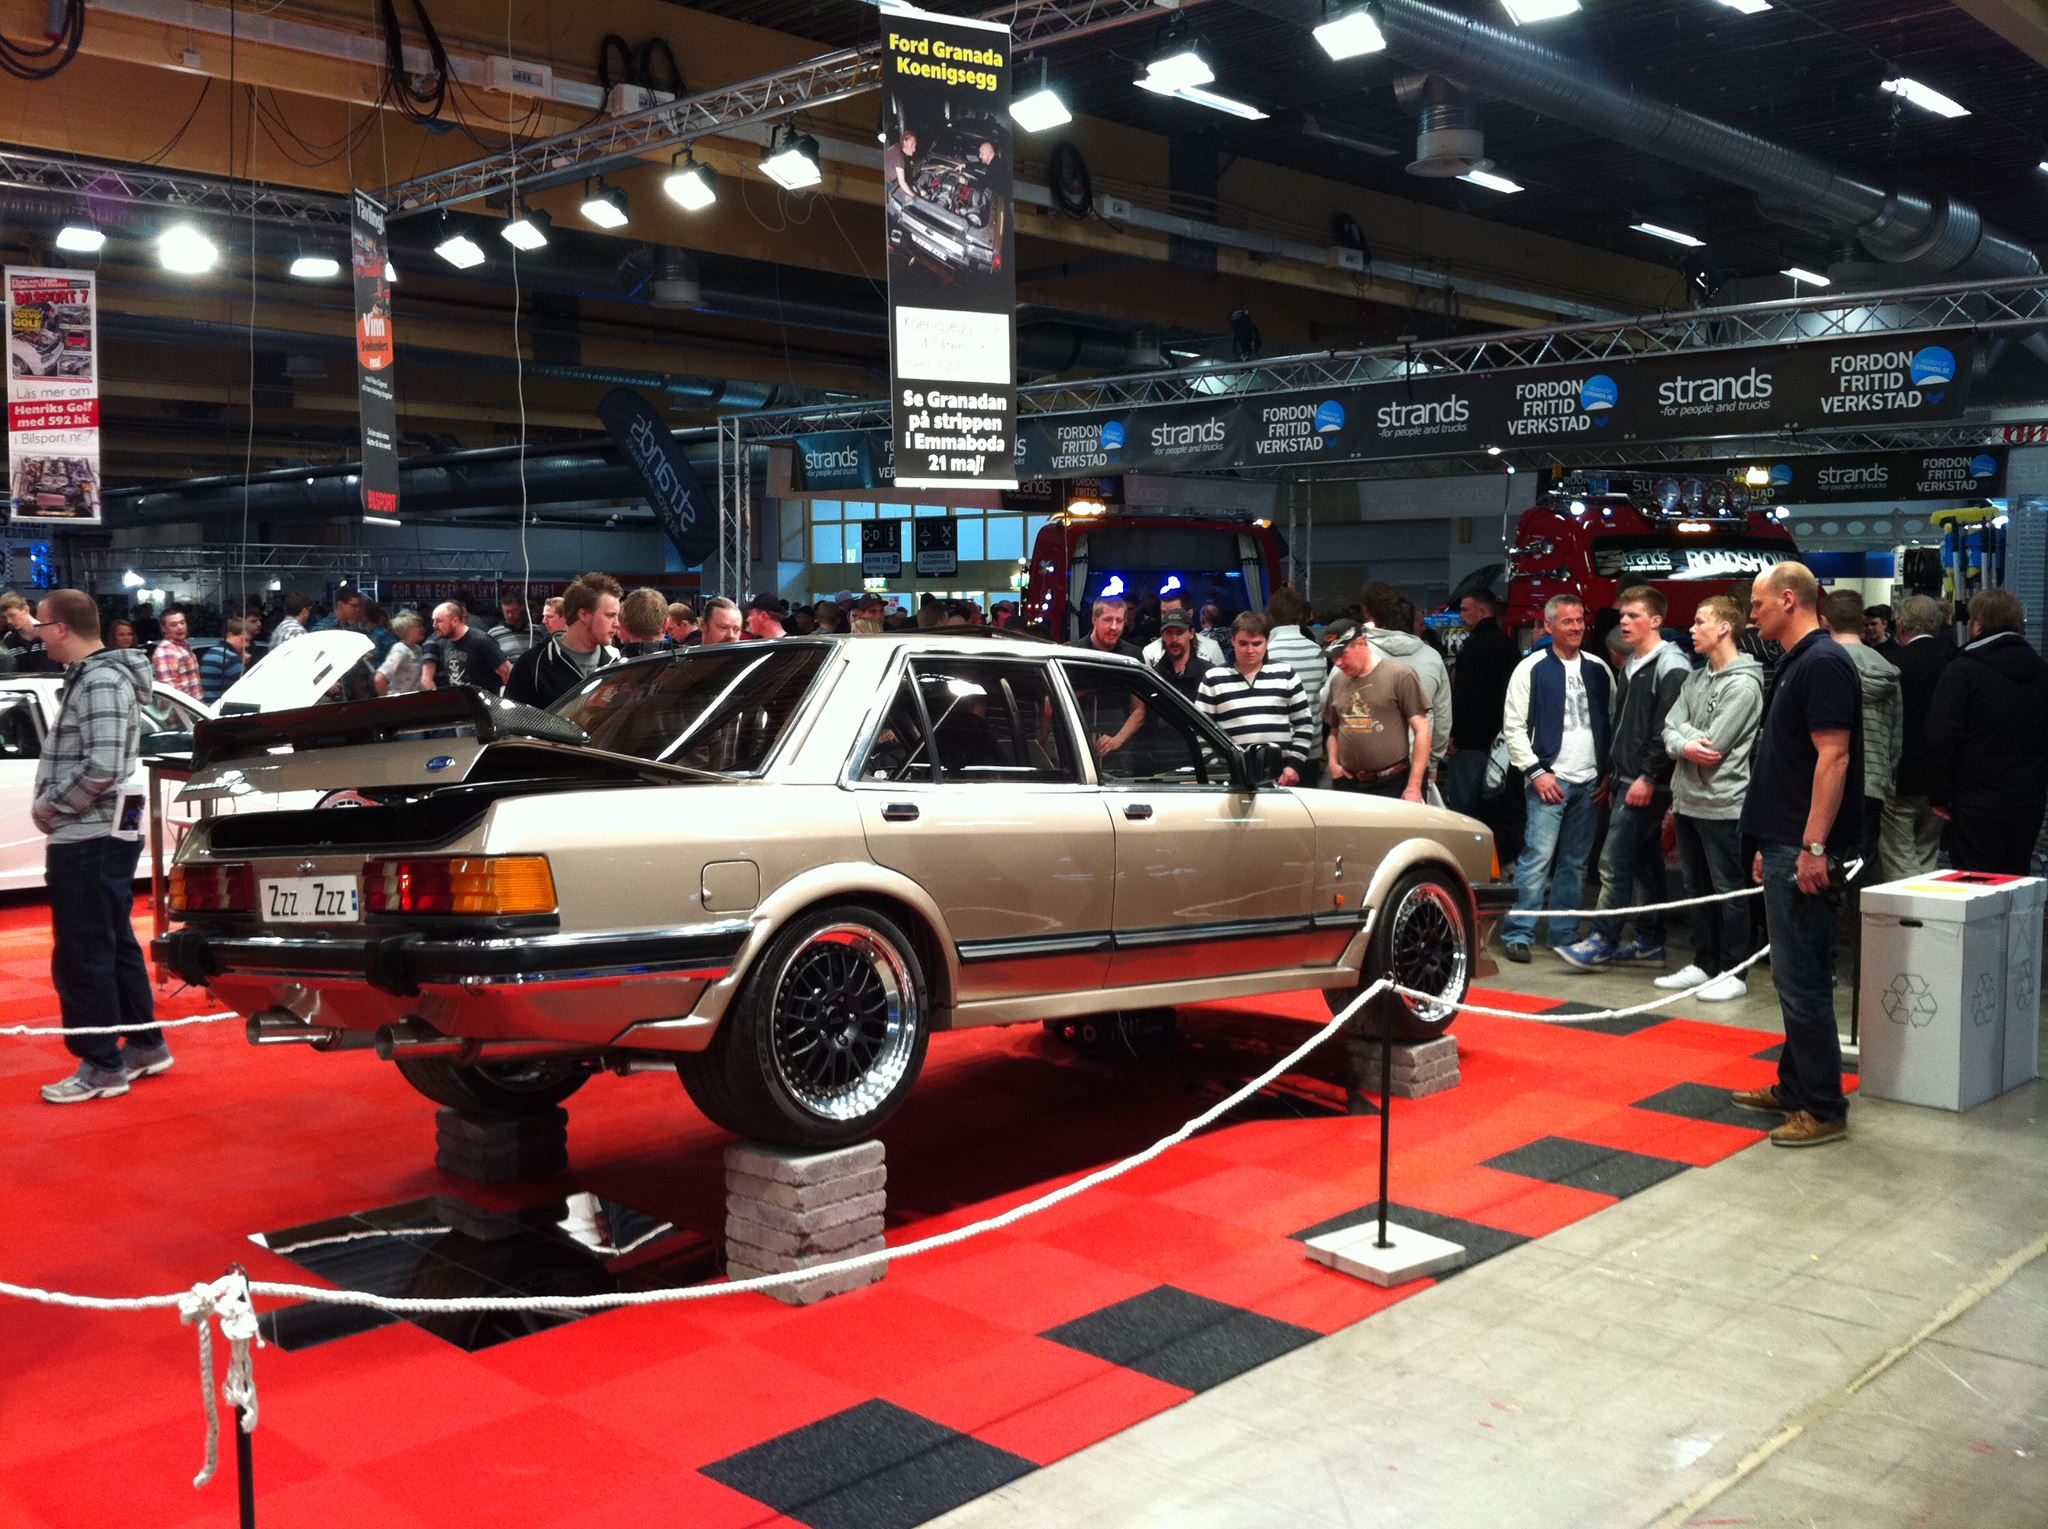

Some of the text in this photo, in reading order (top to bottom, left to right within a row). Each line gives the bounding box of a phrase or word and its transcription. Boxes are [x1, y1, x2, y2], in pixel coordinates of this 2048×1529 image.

[889, 33, 1004, 67] Ford Granada
[896, 56, 998, 91] Koenigsegg
[80, 289, 89, 304] 7
[362, 312, 386, 337] Vinn
[1830, 350, 1914, 374] FORDON
[41, 386, 66, 397] mer
[69, 387, 90, 397] om
[1516, 379, 1584, 400] FORDON
[1658, 367, 1773, 405] strands
[1839, 371, 1904, 393] FRITID
[14, 401, 94, 416] Henriks Golf
[903, 389, 1008, 411] Se Granadan
[1523, 398, 1576, 417] FRITID
[1660, 399, 1771, 418] -for people and trucks
[1820, 390, 1923, 413] VERKSTAD
[17, 414, 91, 428] med 592 hk
[1262, 404, 1318, 423] FORDON
[1377, 394, 1469, 428] strands
[908, 409, 1003, 434] på strippen
[1151, 417, 1226, 446] strands
[1268, 421, 1311, 438] FRITID
[1394, 426, 1423, 438] people
[1423, 424, 1441, 434] and
[1441, 422, 1468, 433] trucks
[1507, 415, 1591, 436] VERKSTAD
[21, 432, 66, 446] Bilsport
[1057, 424, 1103, 440] FORDON
[914, 432, 1006, 453] Emmaboda
[1062, 439, 1098, 454] FRITID
[1165, 444, 1188, 456] people
[1188, 443, 1202, 453] and
[1202, 442, 1225, 452] trucks
[1256, 436, 1324, 454] VERKSTAD
[805, 445, 859, 470] strands
[927, 453, 986, 476] 21 maj!
[1051, 453, 1108, 469] VERKSTAD
[1922, 457, 1972, 469] FORDON
[1817, 462, 1889, 484] strands
[1928, 469, 1967, 480] FRITID
[1916, 480, 1978, 492] VERKSTAD
[367, 489, 397, 513] BILSPORT
